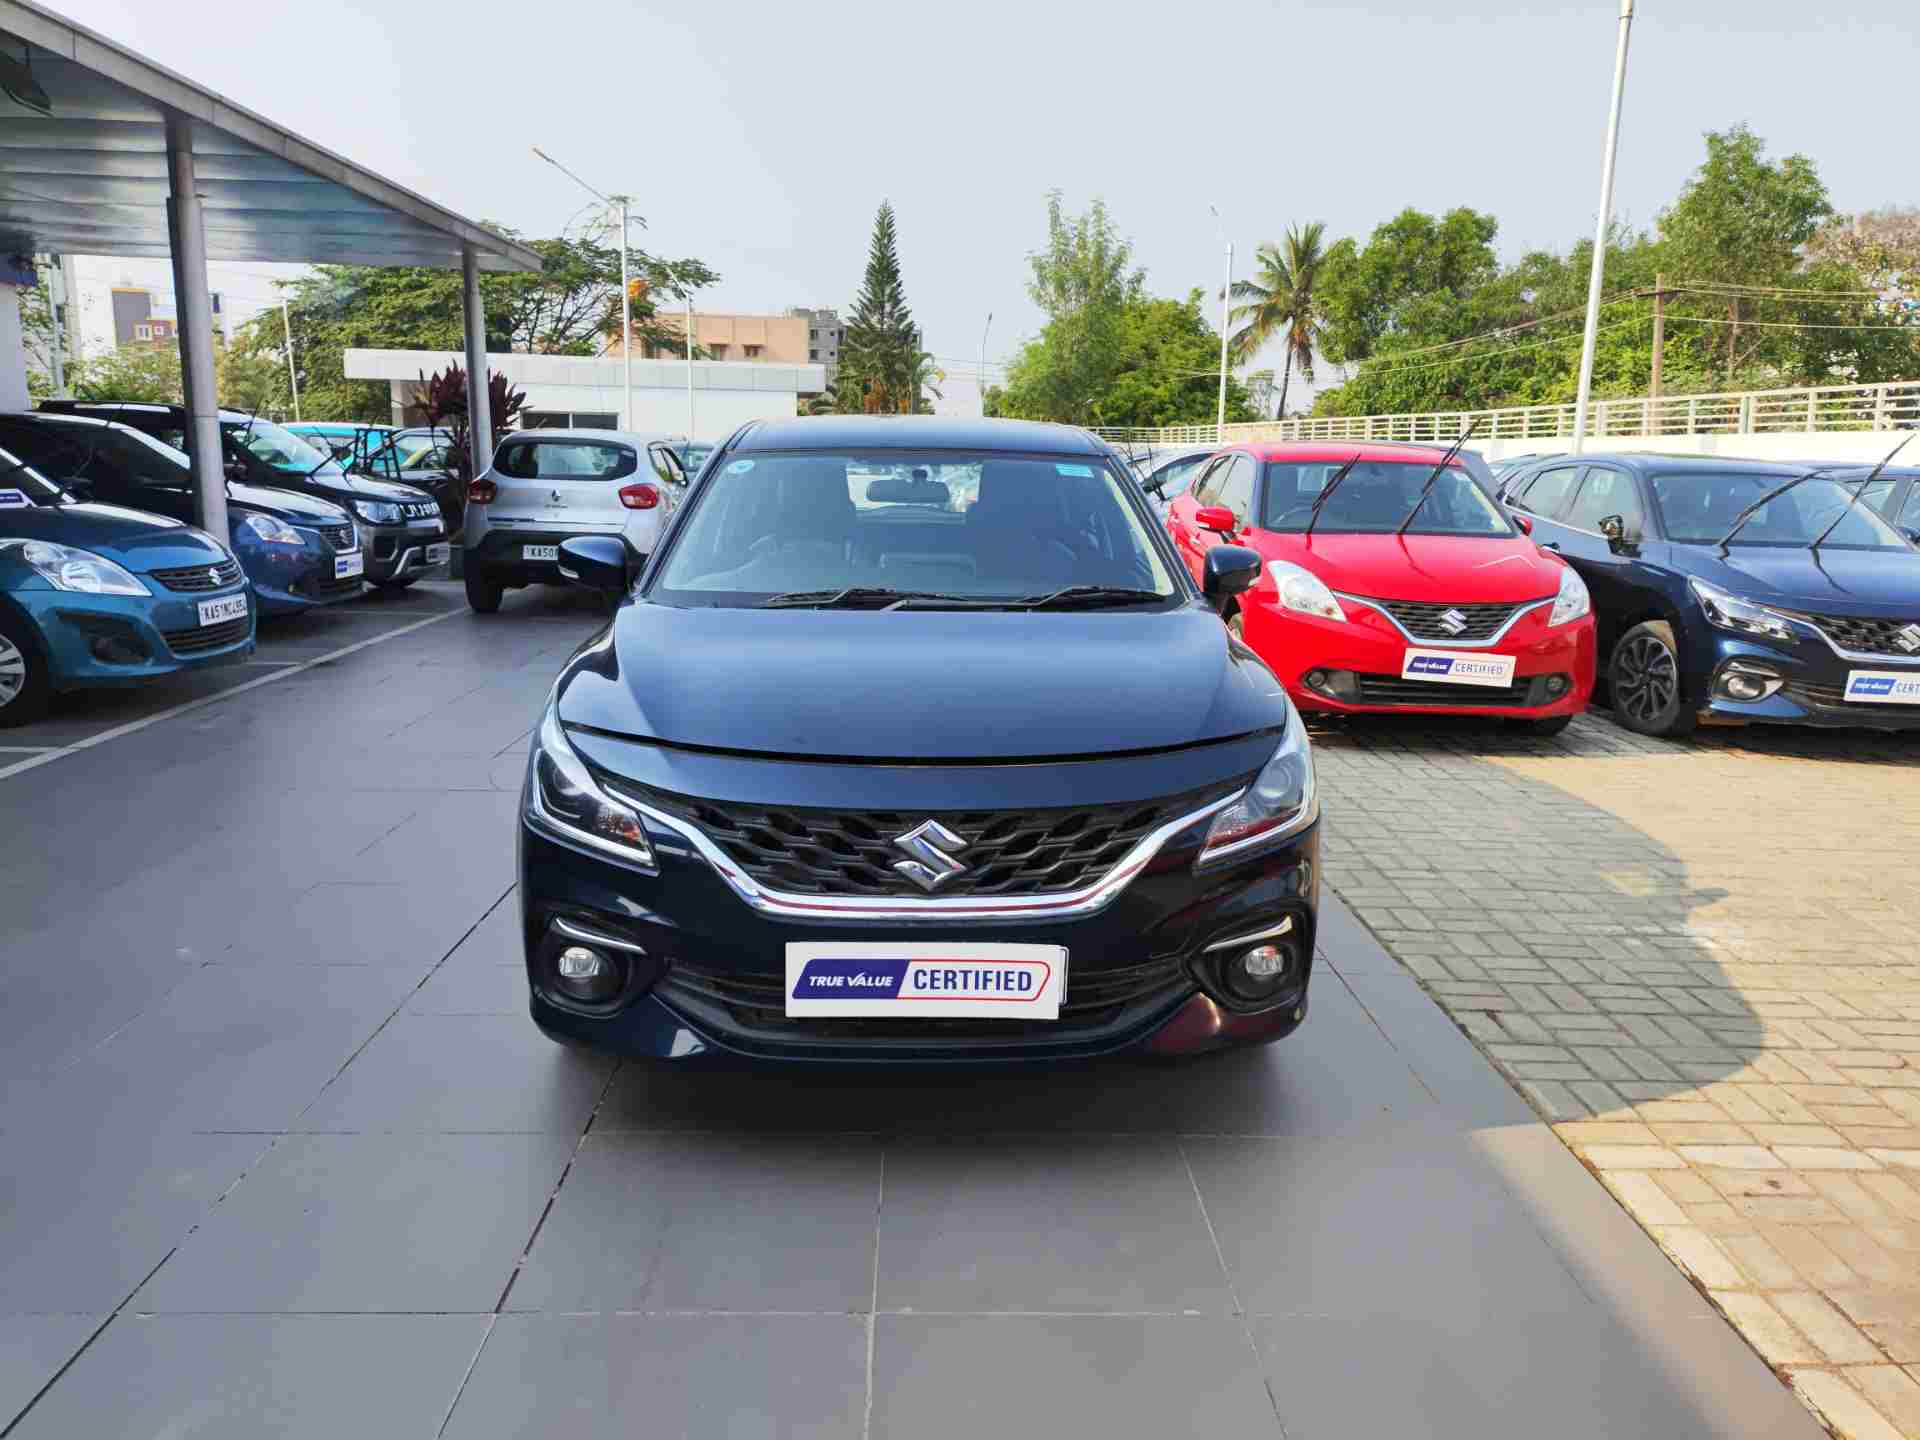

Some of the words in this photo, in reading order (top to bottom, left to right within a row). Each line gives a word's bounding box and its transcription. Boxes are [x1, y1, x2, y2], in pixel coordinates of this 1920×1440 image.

[1455, 663, 1504, 674] CERTIFIED
[809, 975, 846, 987] TRUE
[847, 972, 894, 987] VALUE
[912, 968, 1033, 993] CERTIFIED
